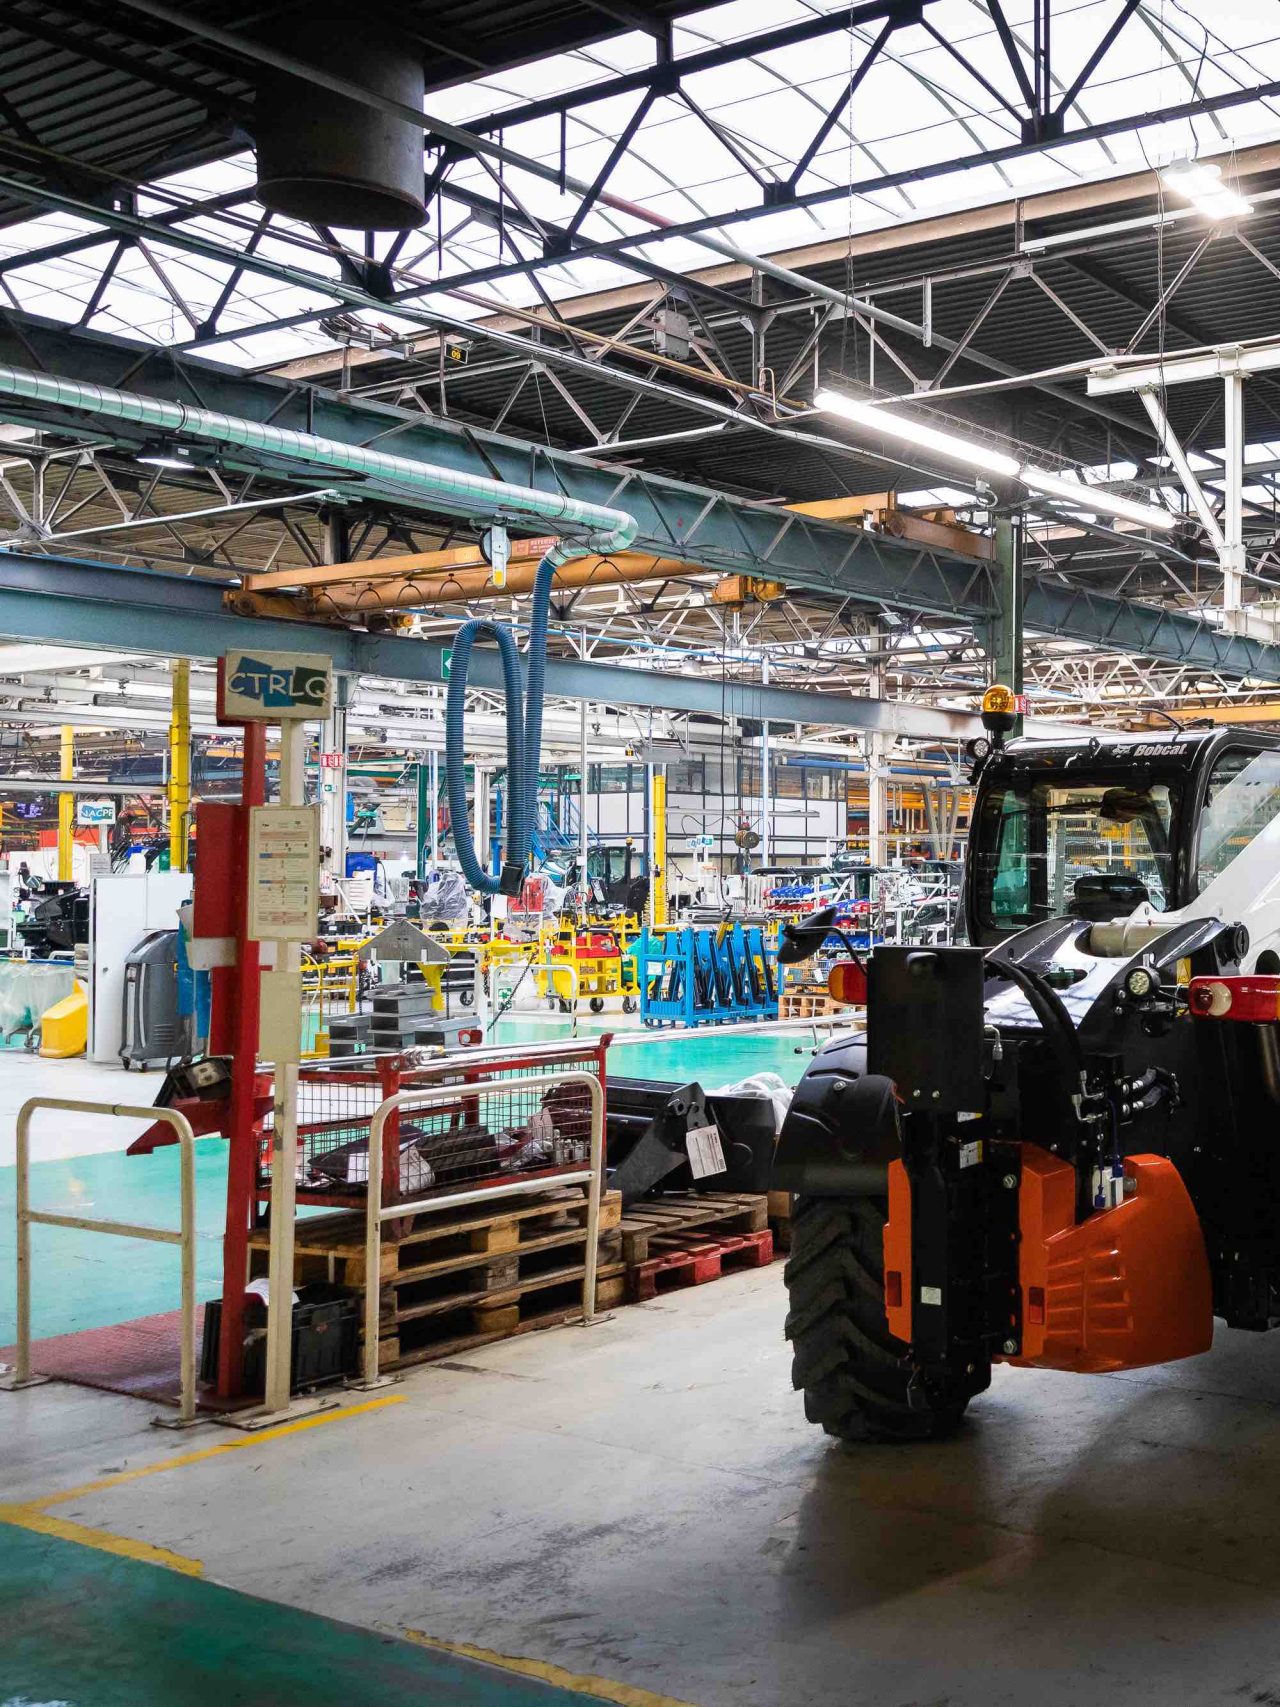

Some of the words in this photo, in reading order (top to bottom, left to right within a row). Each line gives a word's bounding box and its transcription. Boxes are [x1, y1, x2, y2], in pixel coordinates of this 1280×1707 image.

[228, 672, 329, 701] CTRLQ
[1133, 743, 1188, 757] Bobcat
[193, 1062, 220, 1087] B
